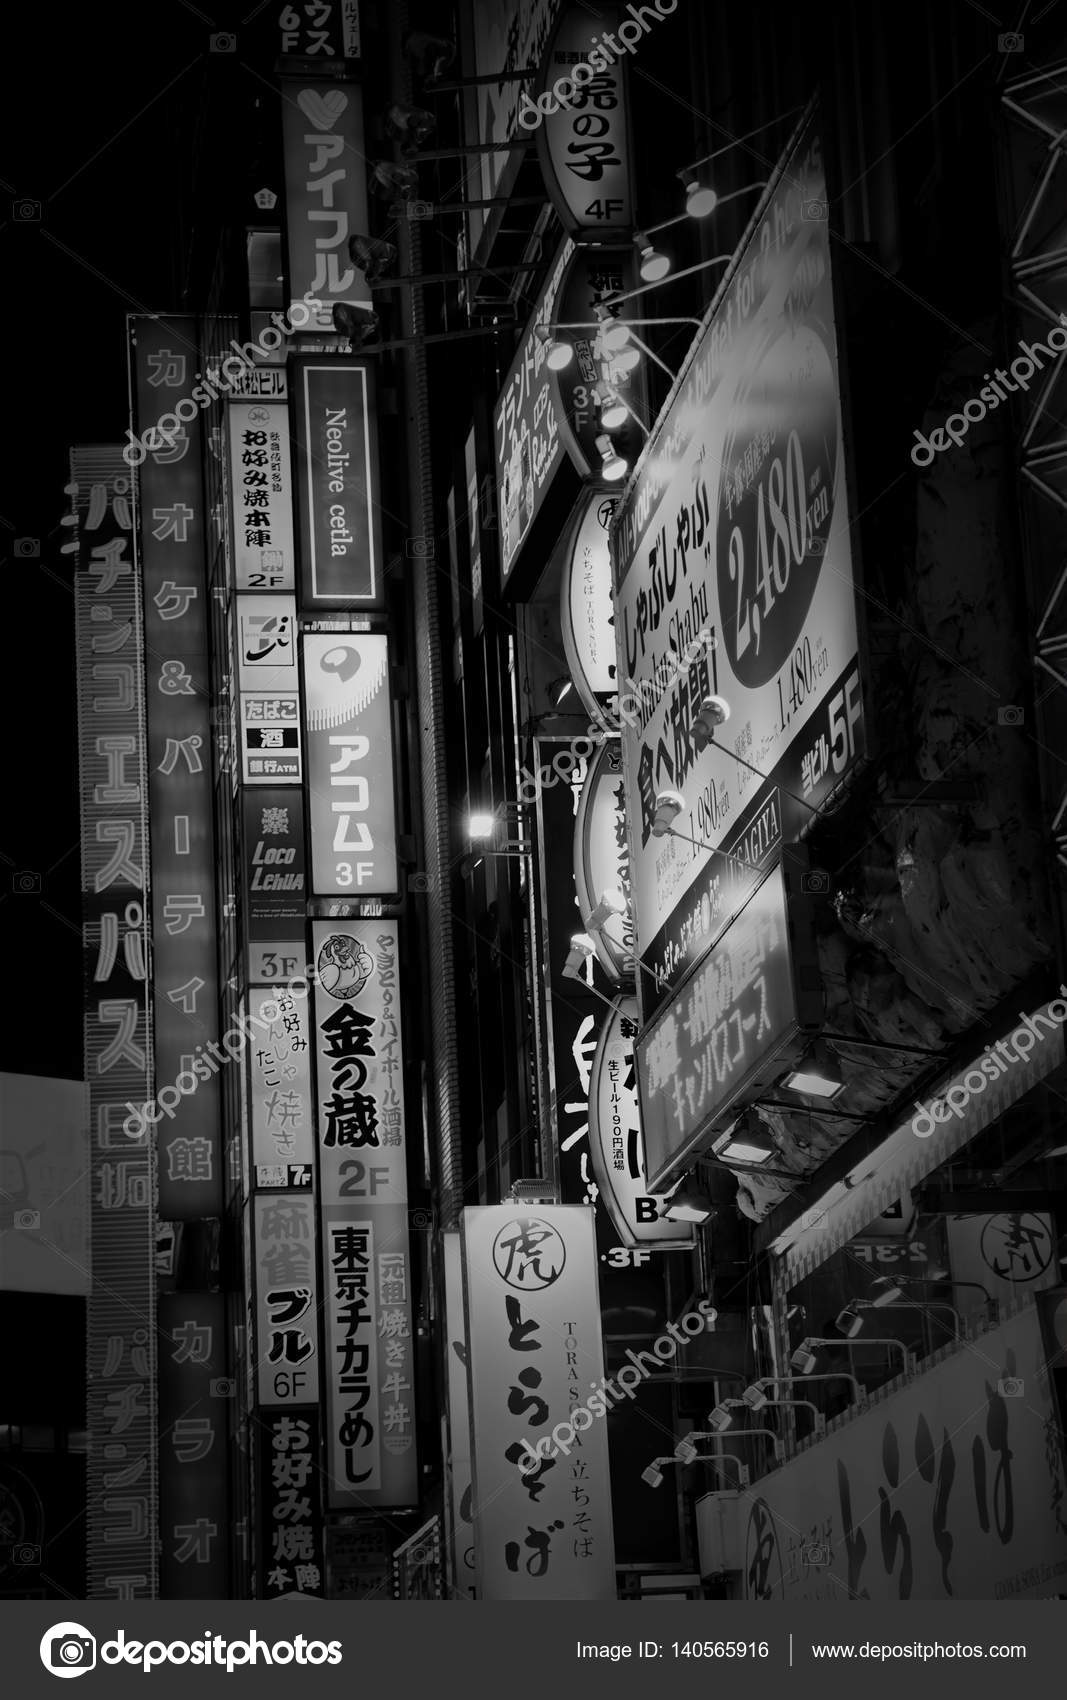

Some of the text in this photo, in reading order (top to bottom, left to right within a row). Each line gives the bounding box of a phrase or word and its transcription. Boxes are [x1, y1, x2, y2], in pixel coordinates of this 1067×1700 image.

[278, 4, 301, 53] 6F
[303, 134, 354, 293] アイフル
[585, 199, 624, 220] 4F
[573, 386, 589, 433] 3F
[325, 407, 348, 494] Neolive
[242, 429, 272, 547] お好み焼本陣
[248, 573, 285, 587] 2F
[246, 700, 297, 720] たばこ
[260, 728, 285, 748] 酒
[827, 667, 863, 774] 5F
[249, 759, 298, 774] 銀行ATM
[328, 735, 375, 852] アコム
[800, 733, 830, 799] 当ビル
[335, 861, 375, 886] 3F
[260, 952, 298, 978] 3F
[277, 994, 308, 1052] お好み
[255, 1049, 281, 1087] たこ
[320, 1003, 379, 1147] 金の蔵
[607, 1059, 625, 1171] 生ビール190円酒場
[289, 1165, 312, 1186] 7F
[338, 1159, 390, 1197] 2F
[494, 1216, 566, 1291] 虎
[331, 1226, 374, 1483] 東京チカラめし
[273, 1371, 307, 1398] 6F
[171, 1320, 218, 1564] カラオ
[504, 1293, 566, 1577] とらそば
[271, 1415, 316, 1561] お好み焼
[569, 1458, 594, 1558] 立ちそば
[267, 1562, 321, 1591] 本陣
